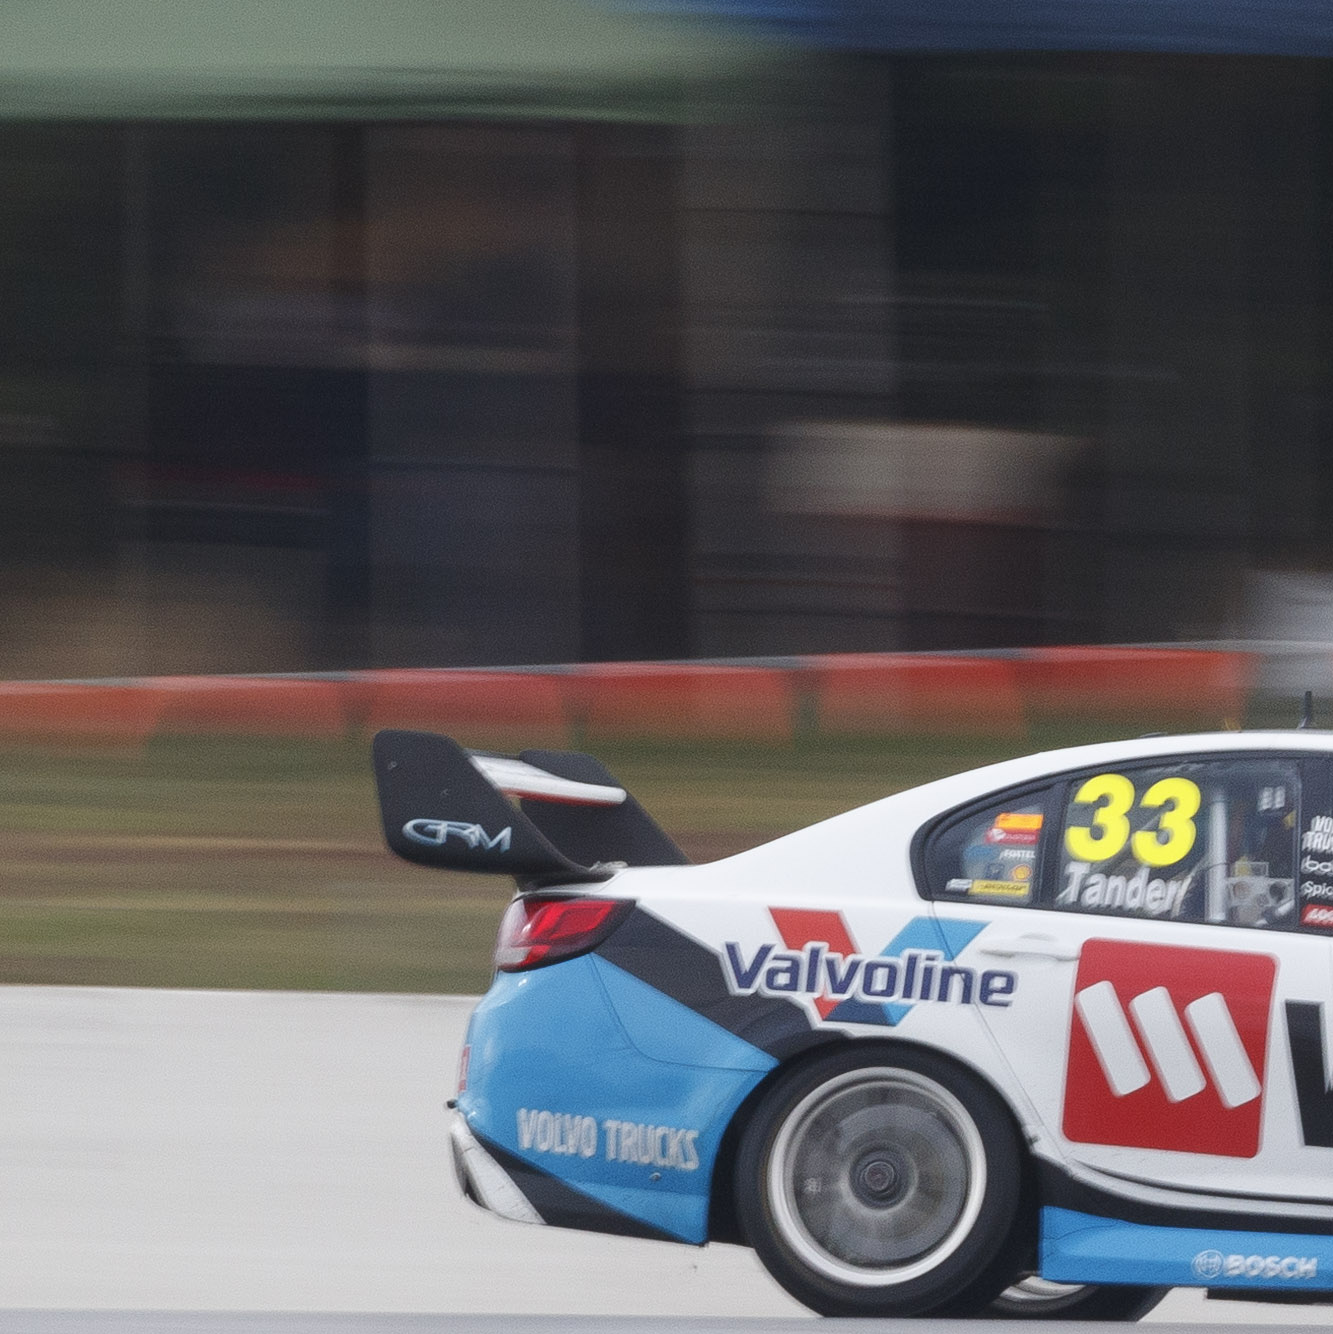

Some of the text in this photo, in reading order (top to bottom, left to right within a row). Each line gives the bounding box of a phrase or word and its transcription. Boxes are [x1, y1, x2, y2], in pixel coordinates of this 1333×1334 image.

[402, 818, 512, 853] GRM
[1064, 773, 1202, 868] 33
[1064, 861, 1182, 915] Tander
[724, 941, 1018, 1008] Valvoline
[517, 1108, 700, 1171] VOLVO TRUCKS
[1224, 1254, 1317, 1278] BOSCH
